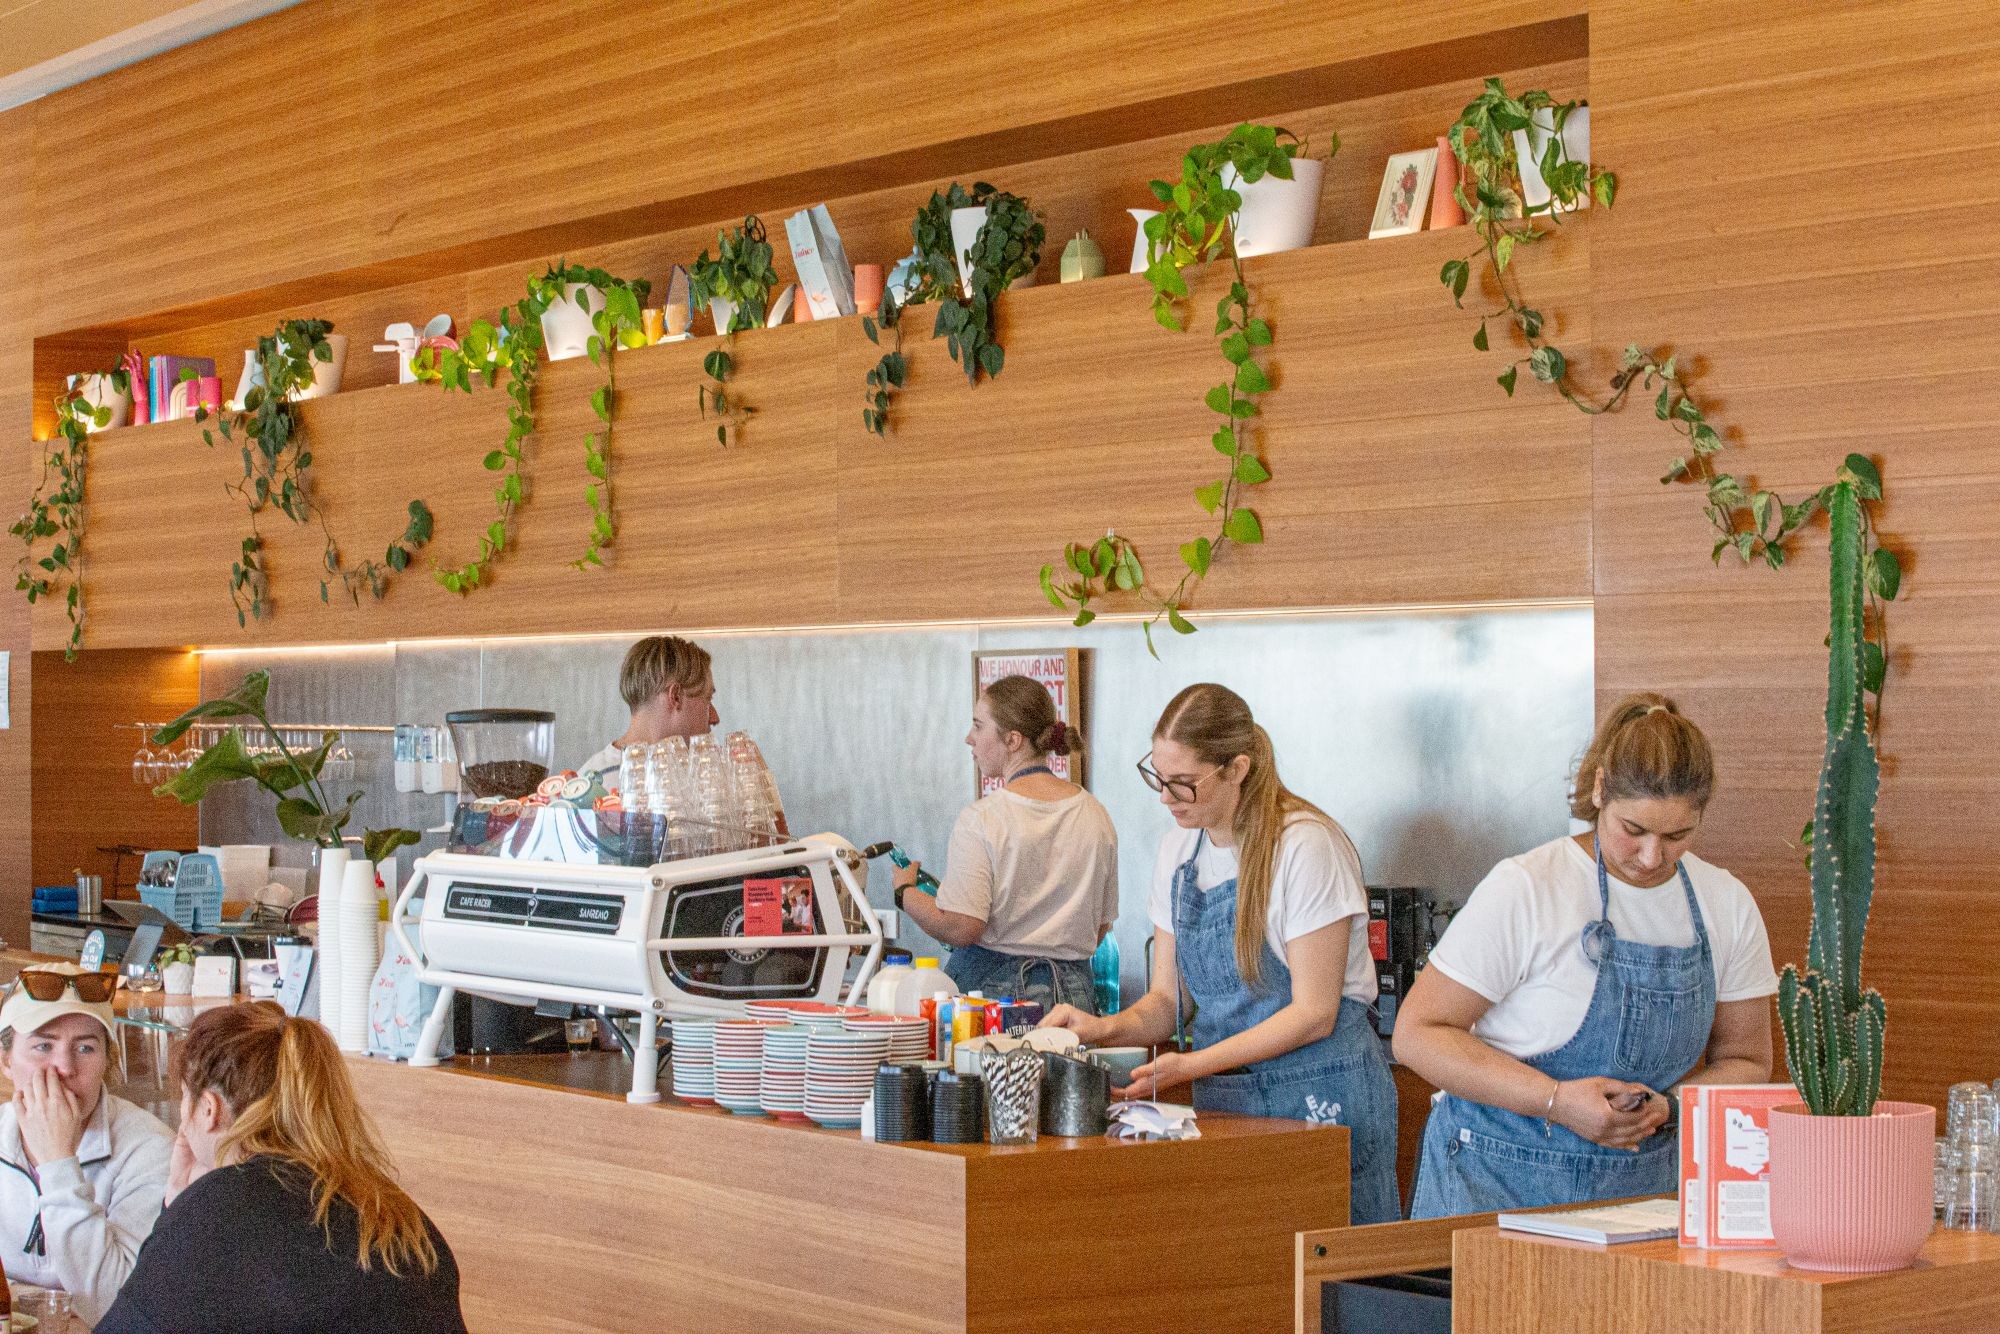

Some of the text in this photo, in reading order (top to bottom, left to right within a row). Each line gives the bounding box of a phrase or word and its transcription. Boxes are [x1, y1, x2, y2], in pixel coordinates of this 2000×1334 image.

[980, 658, 1065, 677] WE HONOUR AND
[982, 776, 1005, 791] PEO
[460, 896, 492, 909] CAFE RACER
[578, 907, 609, 921] SANREMO
[1005, 1024, 1036, 1036] ALTERNAT
